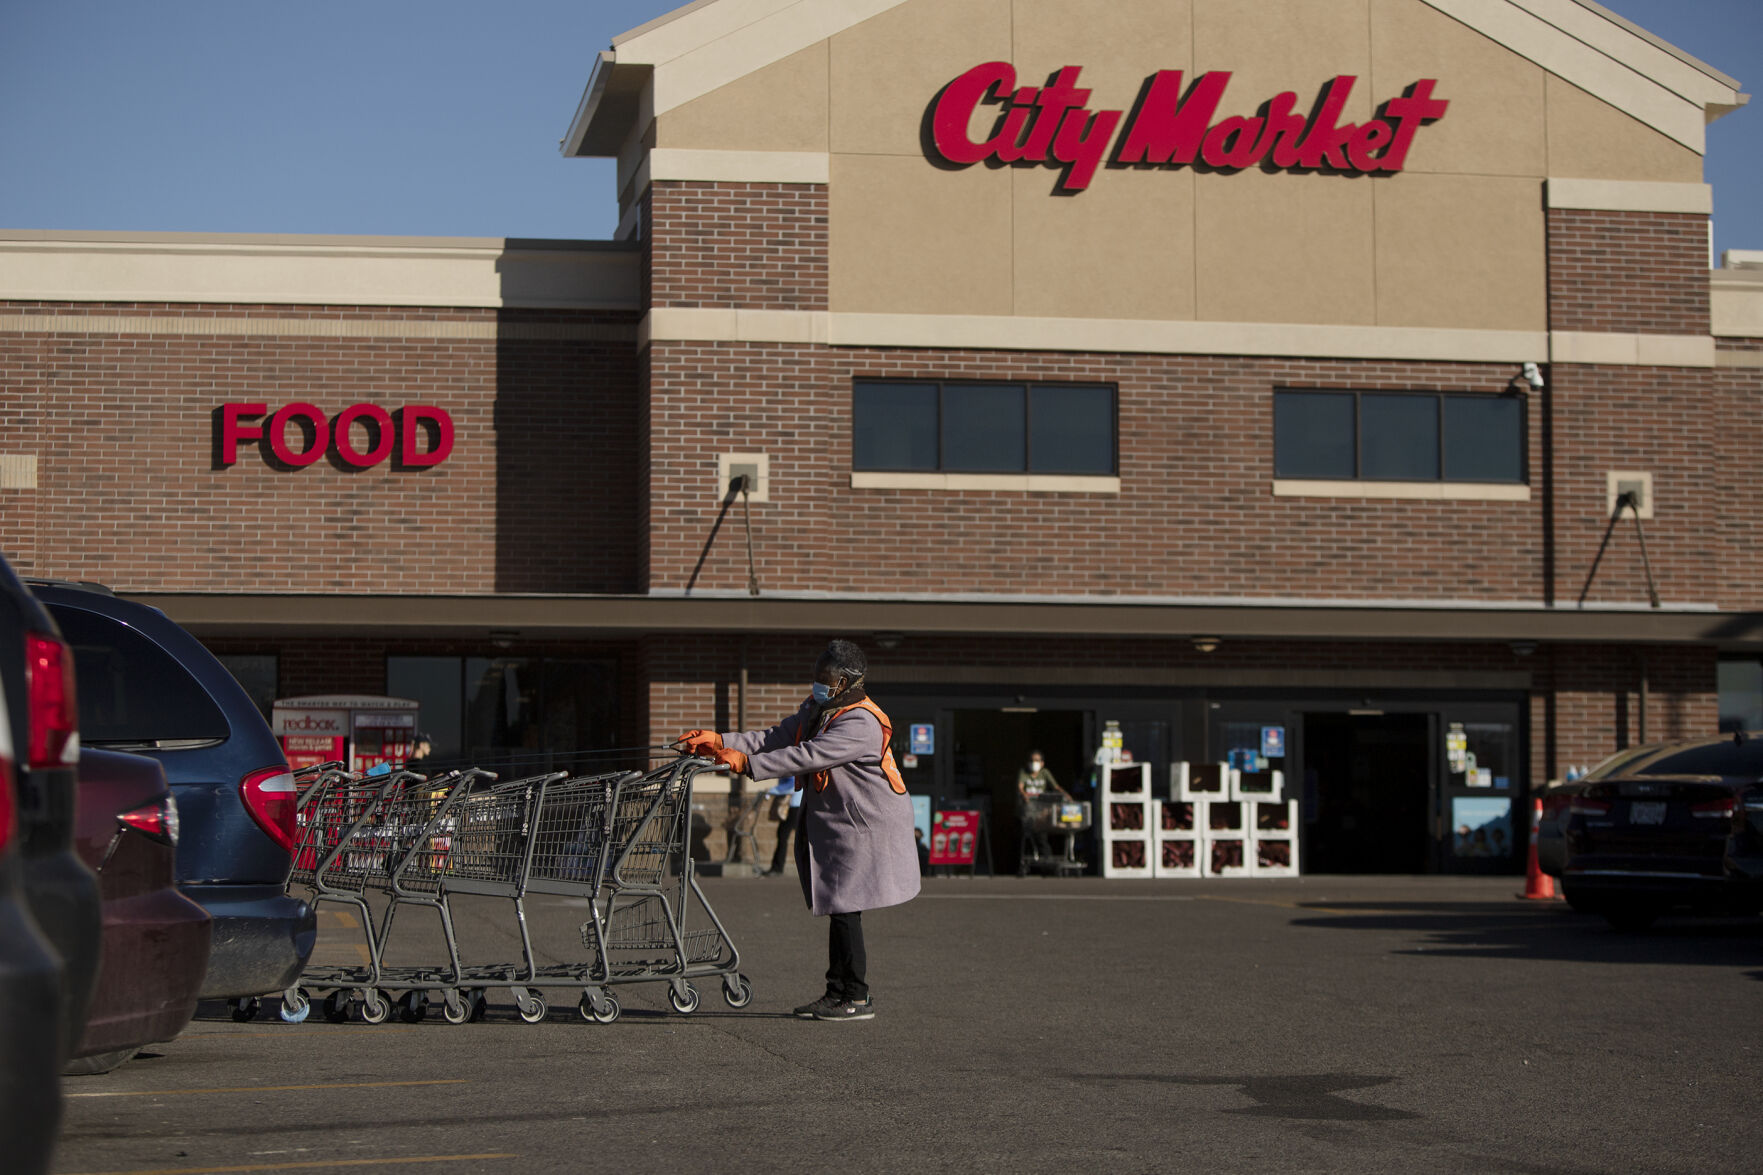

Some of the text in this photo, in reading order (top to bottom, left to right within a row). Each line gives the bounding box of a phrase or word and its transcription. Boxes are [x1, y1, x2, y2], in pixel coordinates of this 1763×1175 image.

[932, 60, 1451, 190] City Market
[222, 401, 455, 467] FOOD
